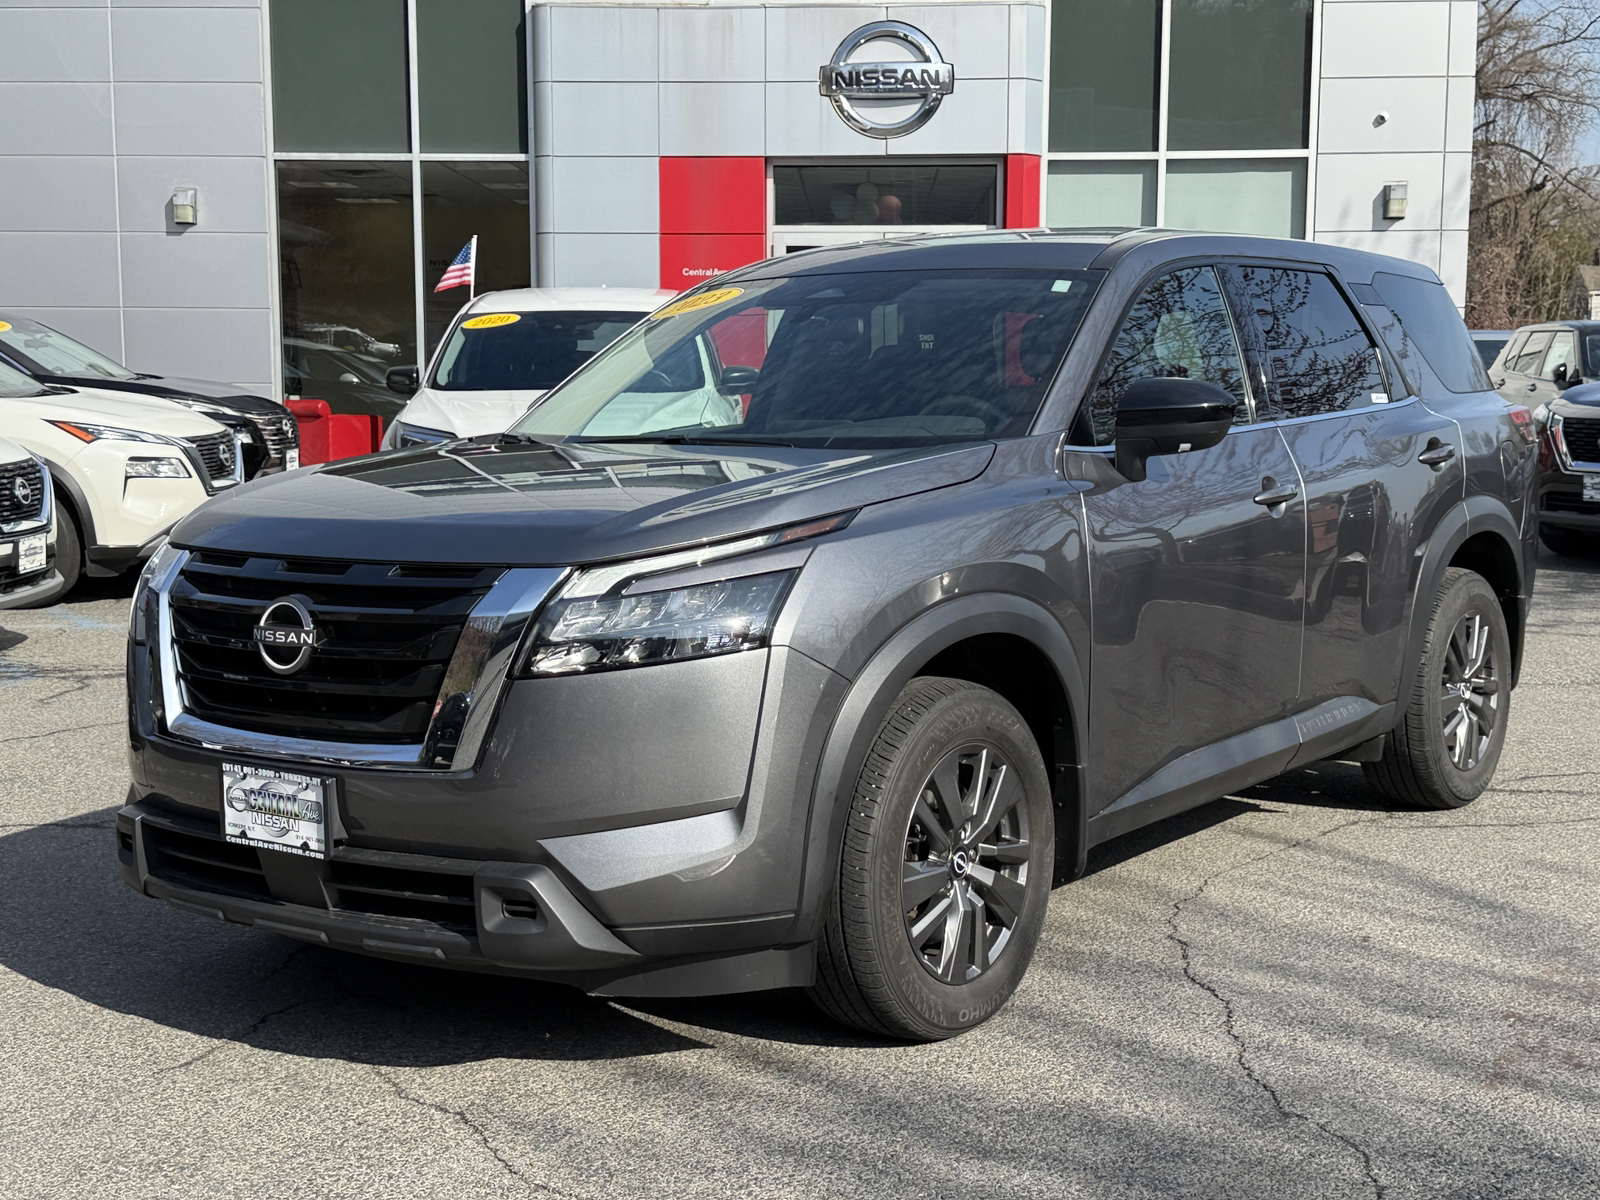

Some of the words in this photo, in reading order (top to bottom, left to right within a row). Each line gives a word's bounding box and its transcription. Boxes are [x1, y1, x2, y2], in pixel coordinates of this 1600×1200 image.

[832, 68, 940, 88] NISSAN
[682, 267, 713, 276] Central
[661, 290, 733, 315] 2023
[472, 315, 510, 327] 2020
[253, 628, 313, 644] NISSAN
[249, 788, 301, 818] CENTRAL
[252, 812, 299, 832] NISSAN
[958, 984, 1008, 1022] KUMHO
